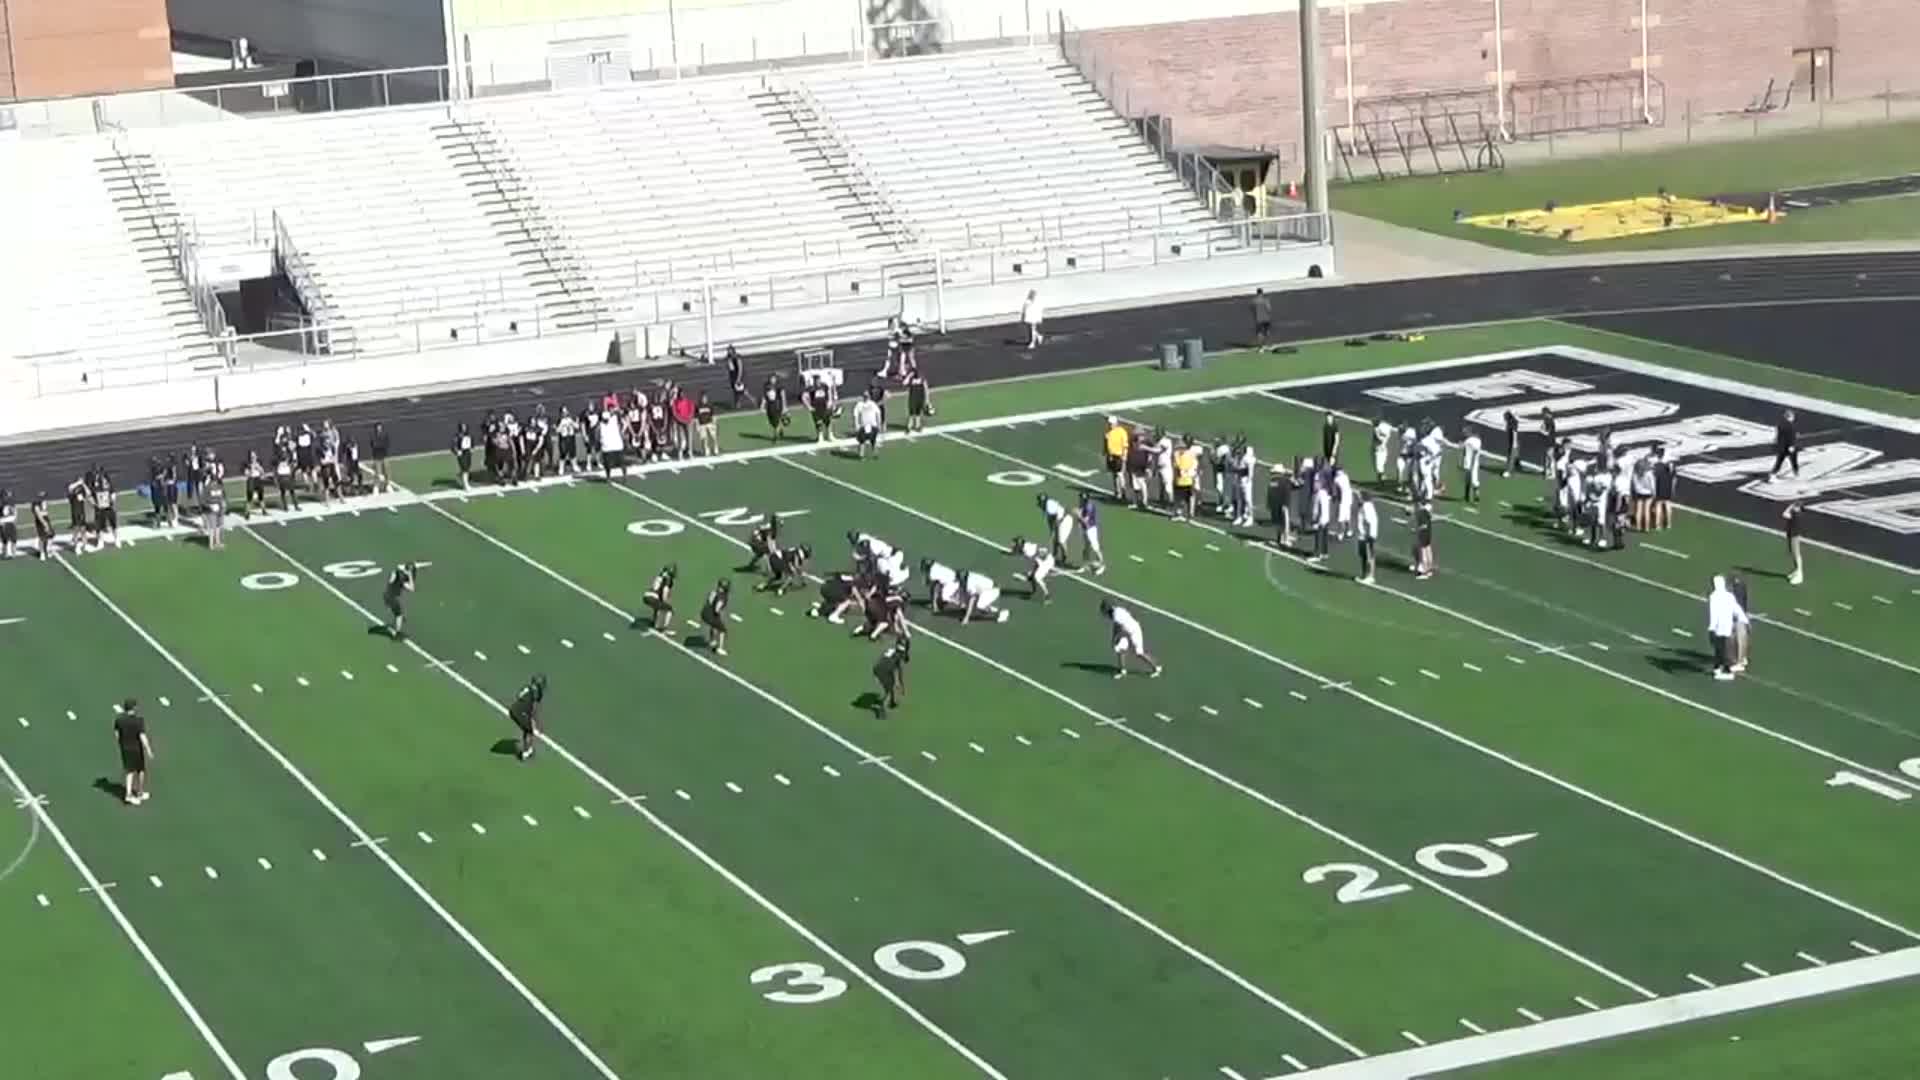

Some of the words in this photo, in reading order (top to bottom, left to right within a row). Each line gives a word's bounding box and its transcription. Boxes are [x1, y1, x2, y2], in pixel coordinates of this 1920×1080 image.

[1825, 757, 1920, 800] 1
[1303, 843, 1509, 903] 20
[750, 940, 966, 1003] 30
